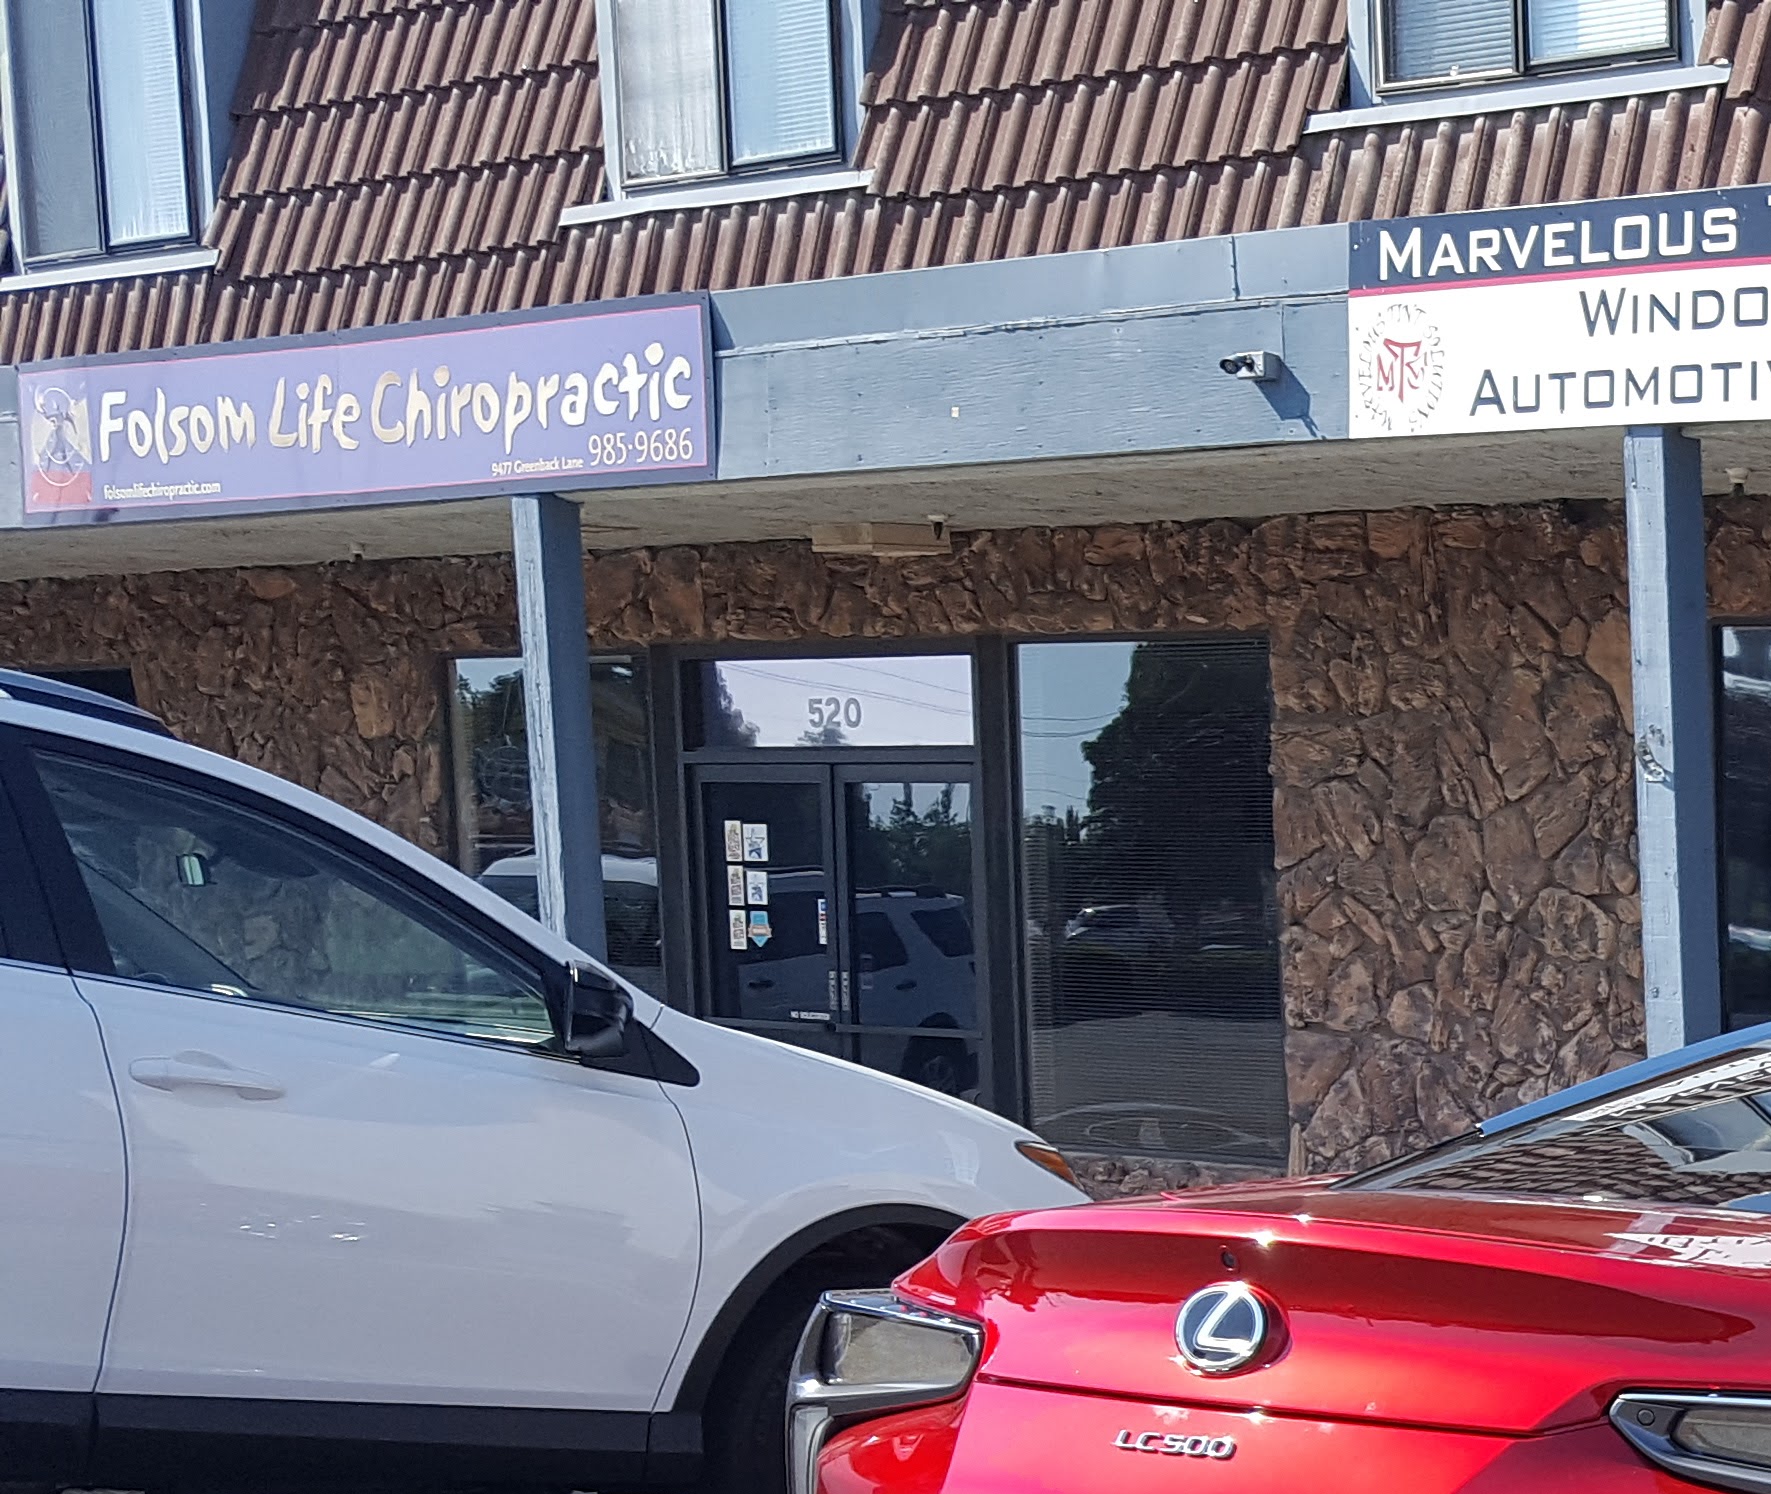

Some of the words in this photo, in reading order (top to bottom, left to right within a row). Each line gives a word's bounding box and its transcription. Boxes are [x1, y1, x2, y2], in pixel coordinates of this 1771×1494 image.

[1378, 205, 1738, 280] MARVELOUS
[100, 388, 256, 465] Folsom
[268, 374, 361, 453] Life
[370, 342, 694, 454] Chiropractic
[562, 456, 585, 469] Lane
[808, 697, 863, 729] 520
